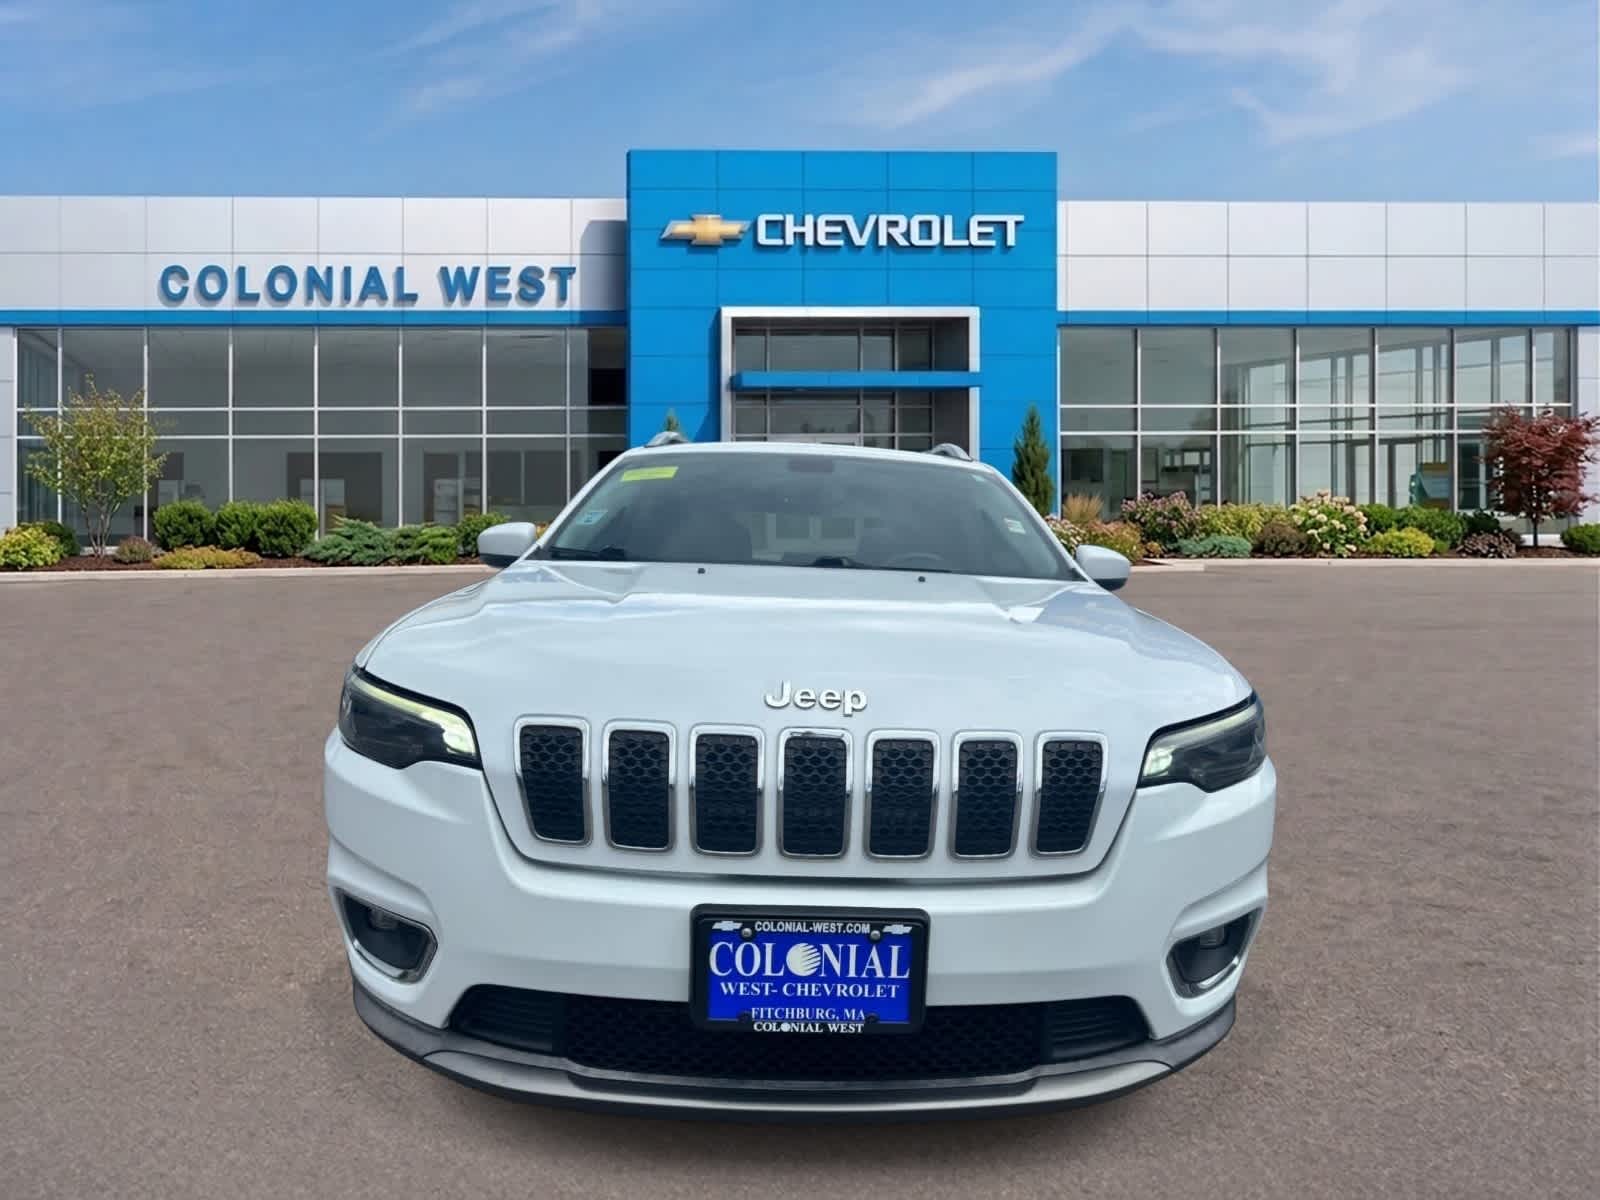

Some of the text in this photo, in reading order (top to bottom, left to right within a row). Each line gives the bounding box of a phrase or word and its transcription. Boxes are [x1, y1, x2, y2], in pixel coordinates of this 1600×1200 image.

[756, 213, 1025, 247] CHEVROLET
[160, 264, 577, 304] COLONIAL WEST
[764, 679, 868, 717] Jeep
[754, 921, 871, 935] COLONIAL-WEST.COM
[708, 941, 911, 979] COLONIAL
[782, 983, 900, 999] CHEVROLET
[843, 1008, 866, 1021] MA
[753, 1022, 865, 1034] COLONIAL WEST
